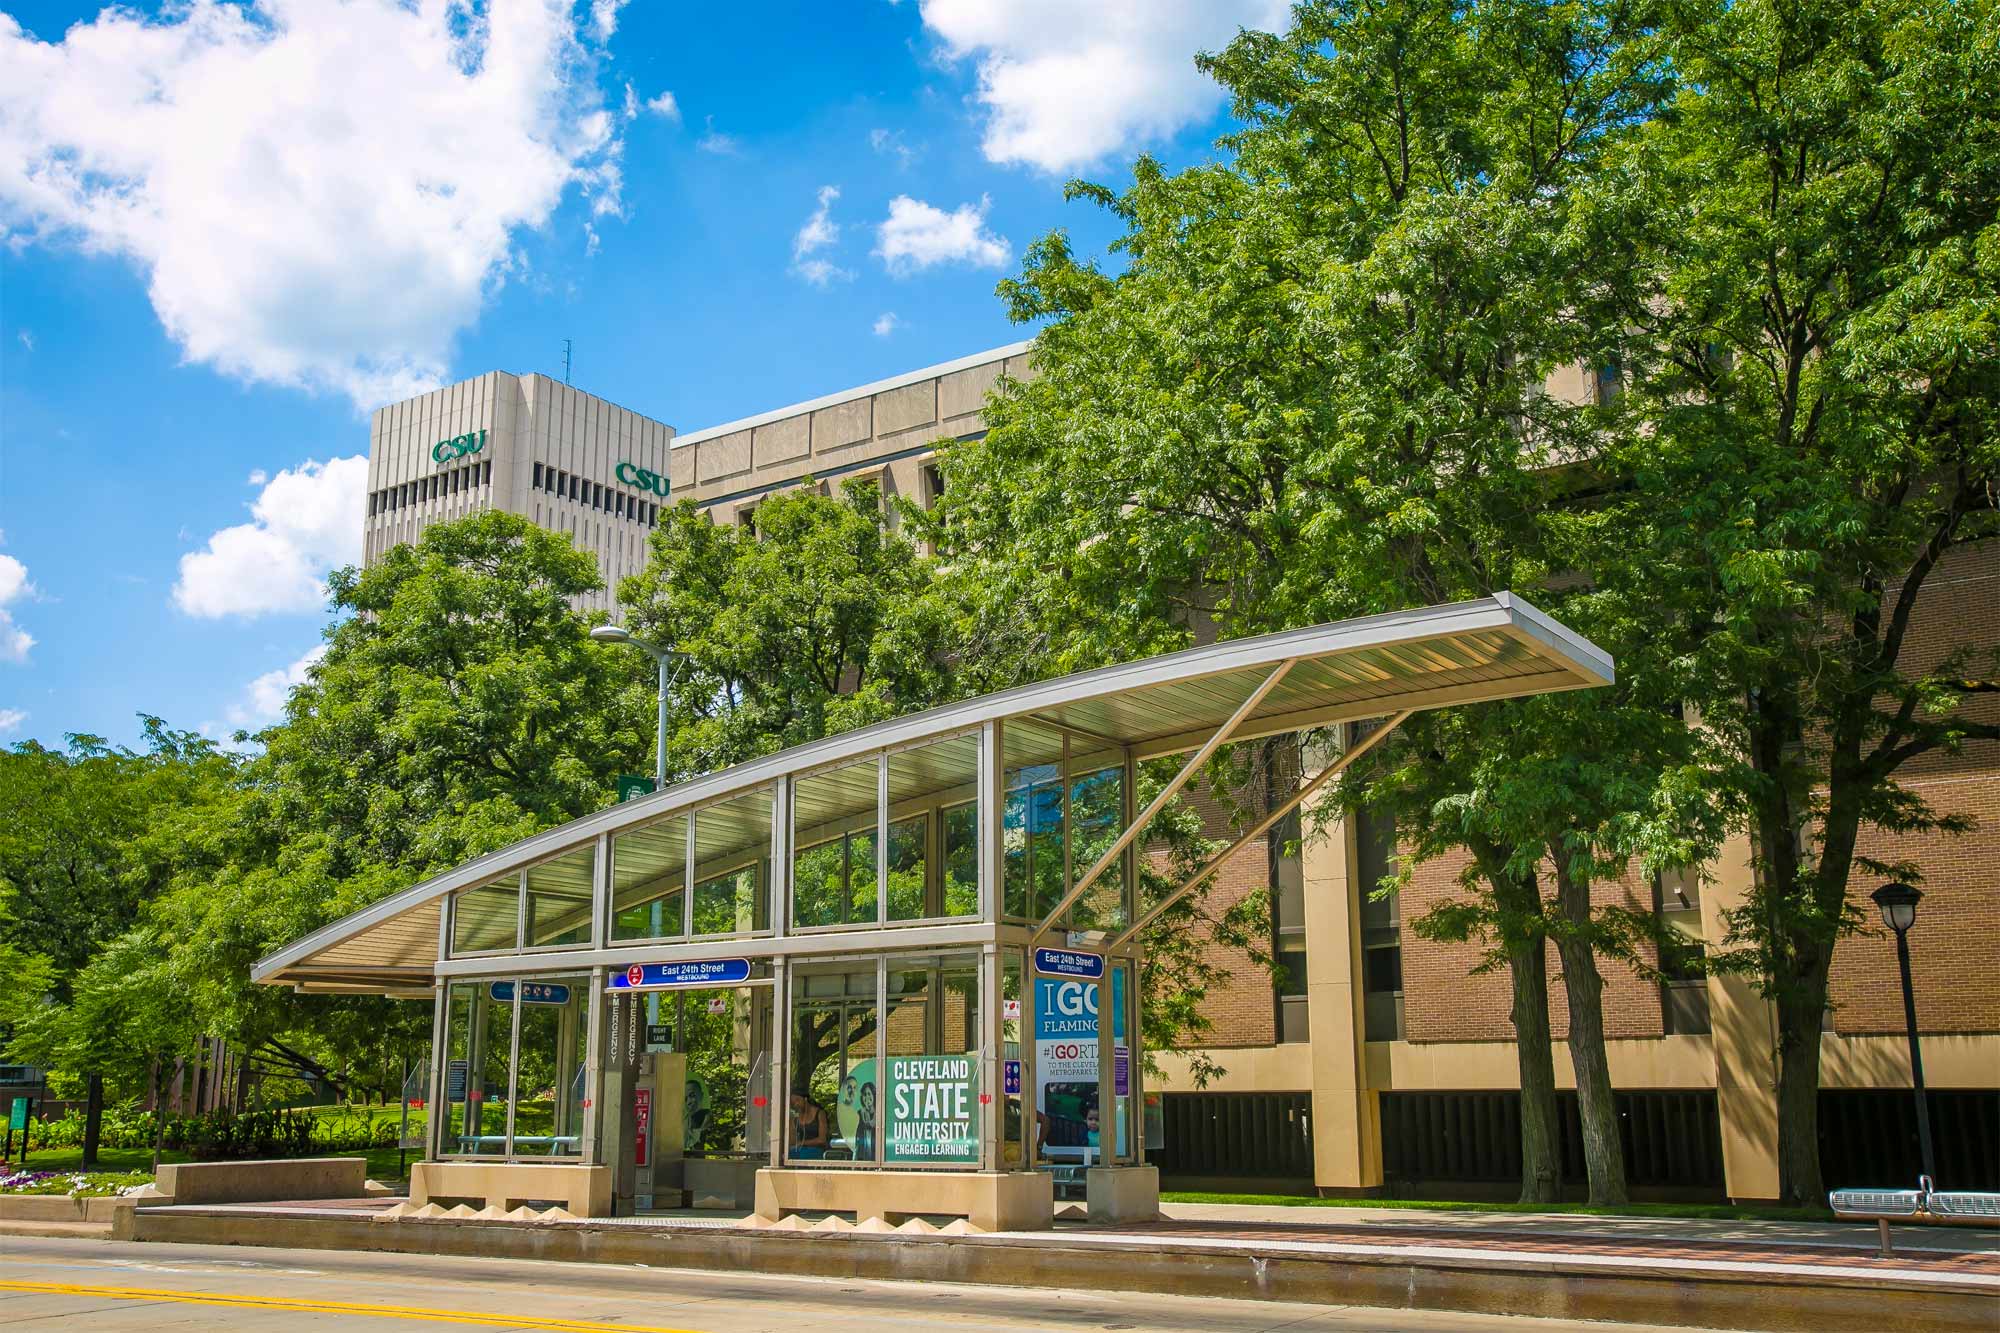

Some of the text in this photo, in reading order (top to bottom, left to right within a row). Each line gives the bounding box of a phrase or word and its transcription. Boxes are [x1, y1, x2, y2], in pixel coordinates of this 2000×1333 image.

[432, 429, 487, 464] CSU
[615, 462, 671, 497] CSU
[1045, 952, 1094, 967] East 24th Street
[1057, 964, 1083, 973] WESTBOUND
[662, 963, 725, 975] East 24th Street
[676, 973, 710, 981] WESTBOUND
[628, 992, 638, 1065] EMERGENCY
[894, 1060, 969, 1080] CLEVELAND
[894, 1082, 970, 1120] STATE
[894, 1122, 970, 1140] UNIVERSITY
[895, 1143, 970, 1155] ENGAGED LEARNING
